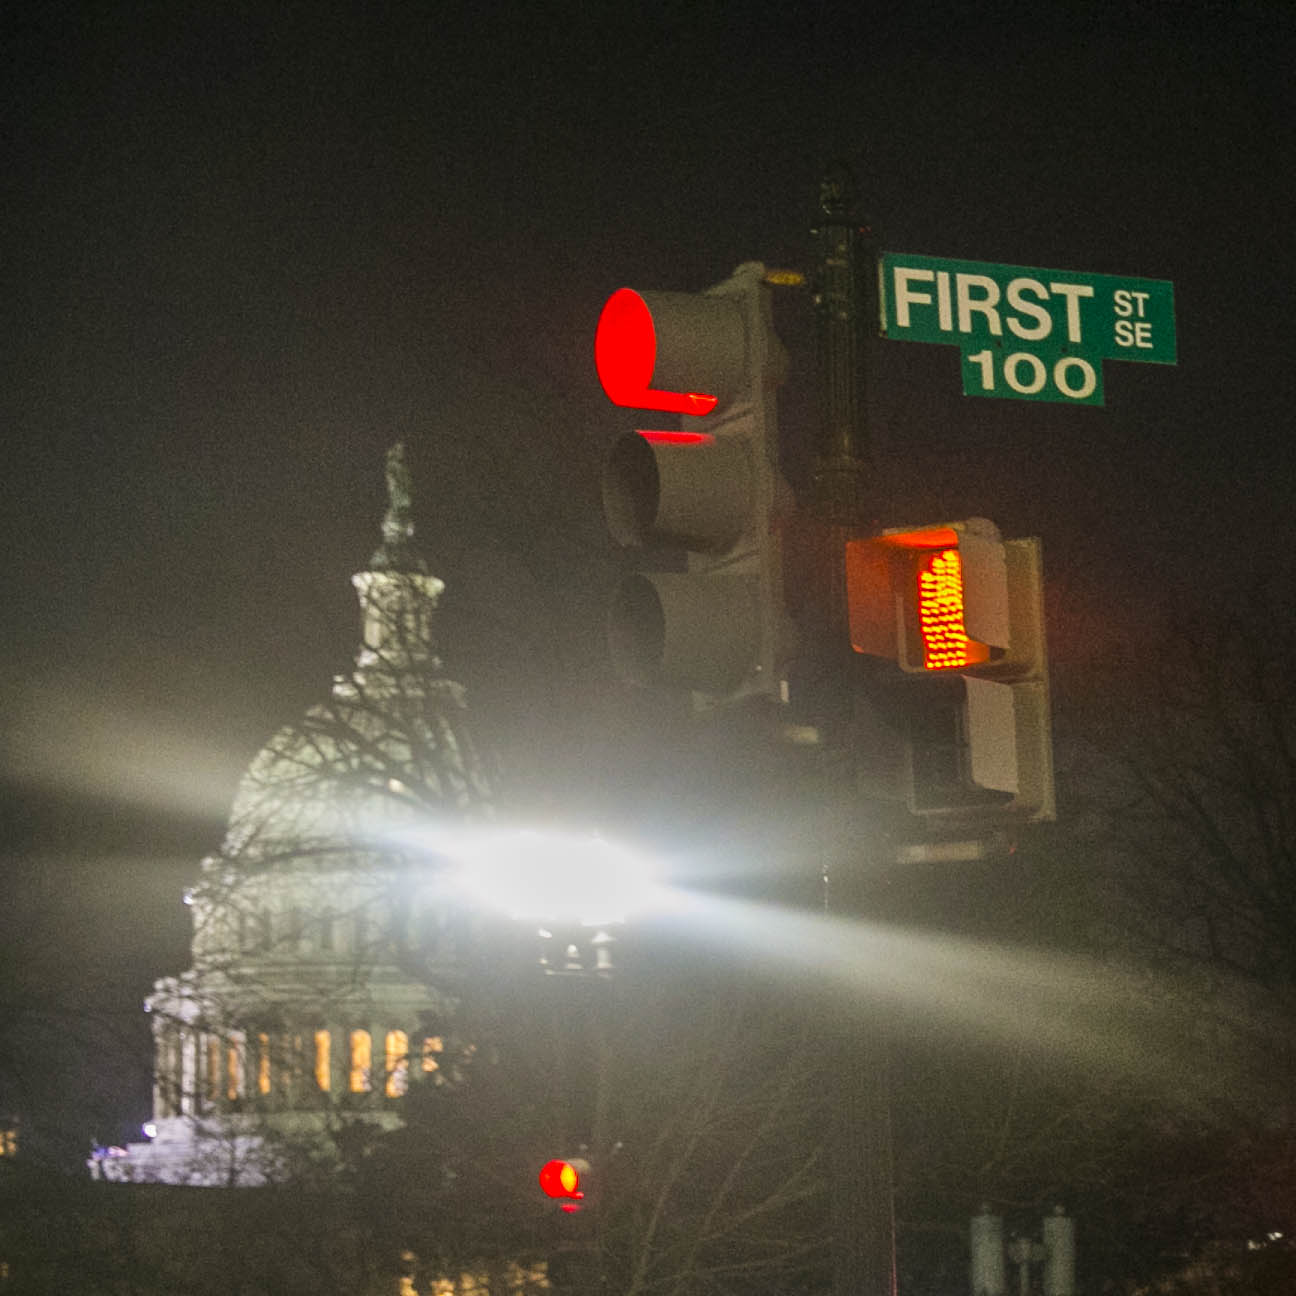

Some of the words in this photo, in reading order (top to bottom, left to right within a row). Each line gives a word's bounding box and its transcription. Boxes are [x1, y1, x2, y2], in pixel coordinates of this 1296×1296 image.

[894, 267, 1094, 343] FIRST
[1113, 290, 1149, 318] ST
[1114, 321, 1154, 349] SE
[968, 350, 1097, 399] 100
